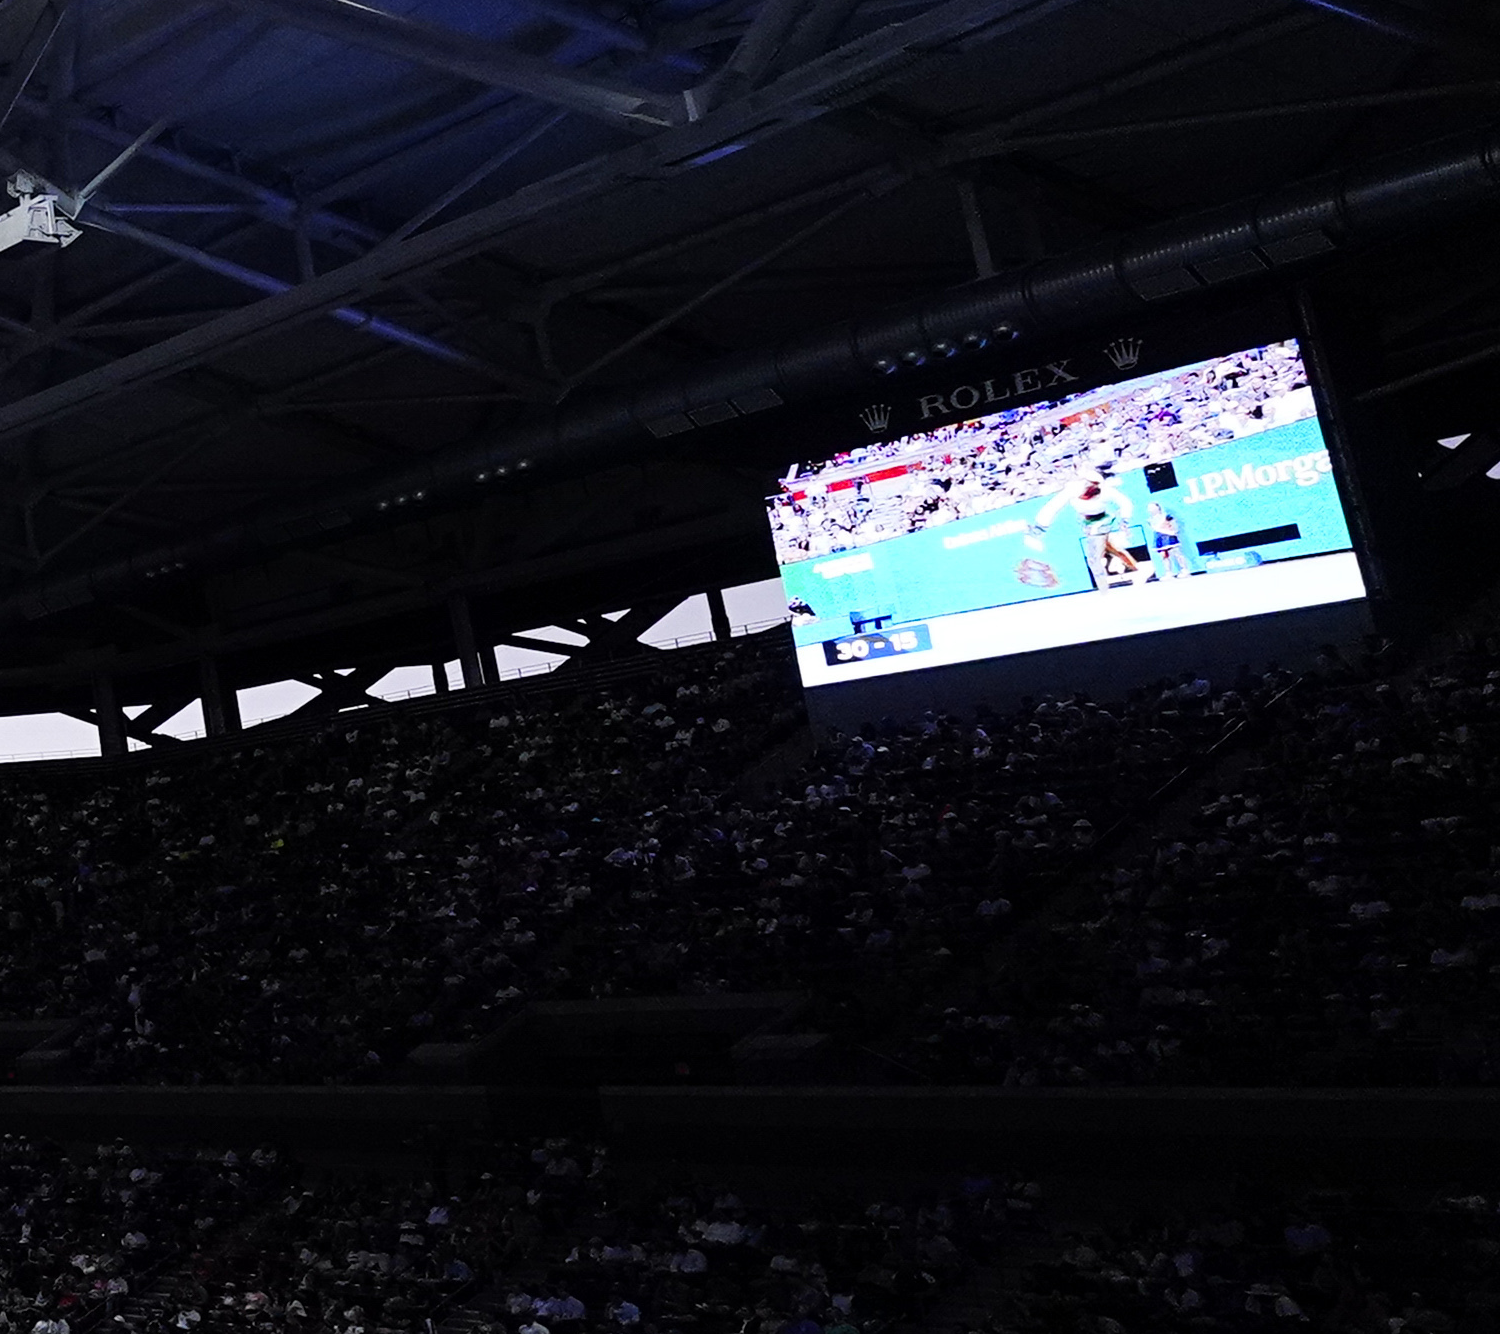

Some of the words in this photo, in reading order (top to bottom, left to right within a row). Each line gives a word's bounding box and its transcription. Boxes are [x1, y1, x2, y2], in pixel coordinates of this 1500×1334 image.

[918, 359, 1080, 421] ROLEX
[835, 635, 870, 662] 30
[888, 630, 919, 654] 15
